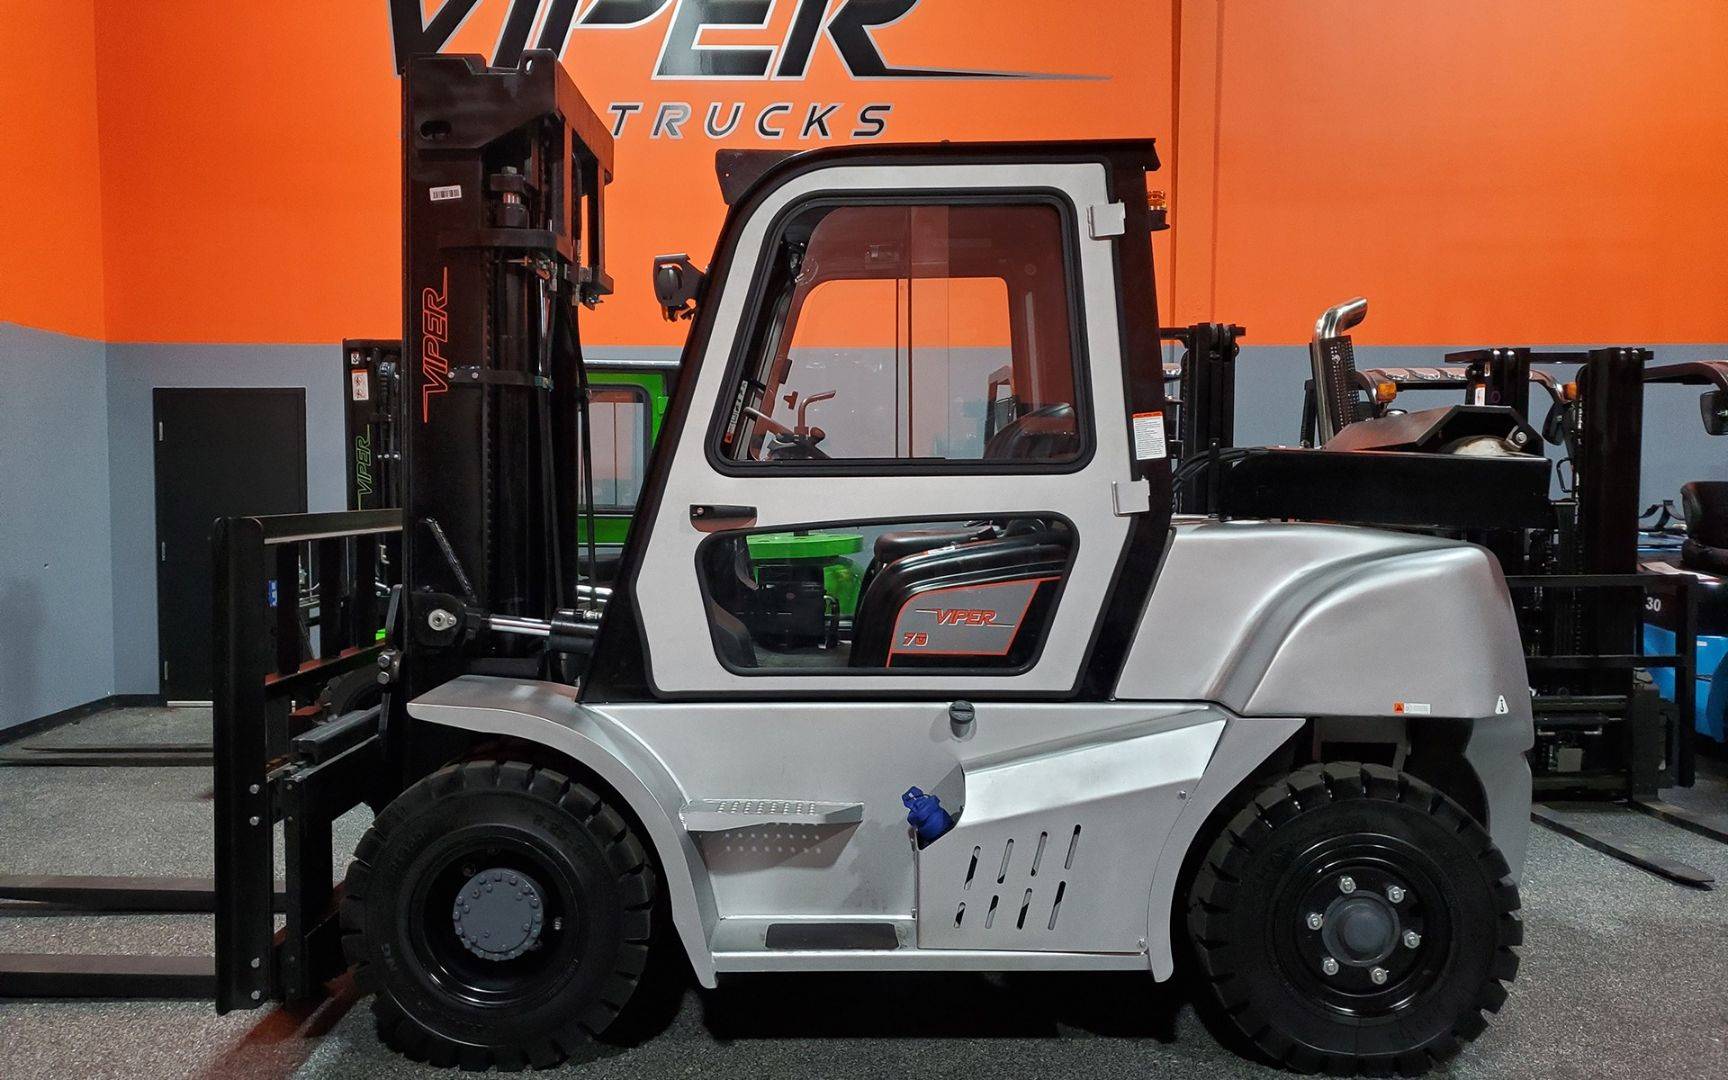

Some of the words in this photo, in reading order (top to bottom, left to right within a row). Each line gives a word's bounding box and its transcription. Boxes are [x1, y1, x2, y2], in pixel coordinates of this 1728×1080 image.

[608, 102, 894, 139] TRUCKS
[423, 266, 448, 423] VIPER
[356, 424, 372, 511] VIPER
[915, 608, 1015, 627] VIPER
[1645, 597, 1662, 611] 30
